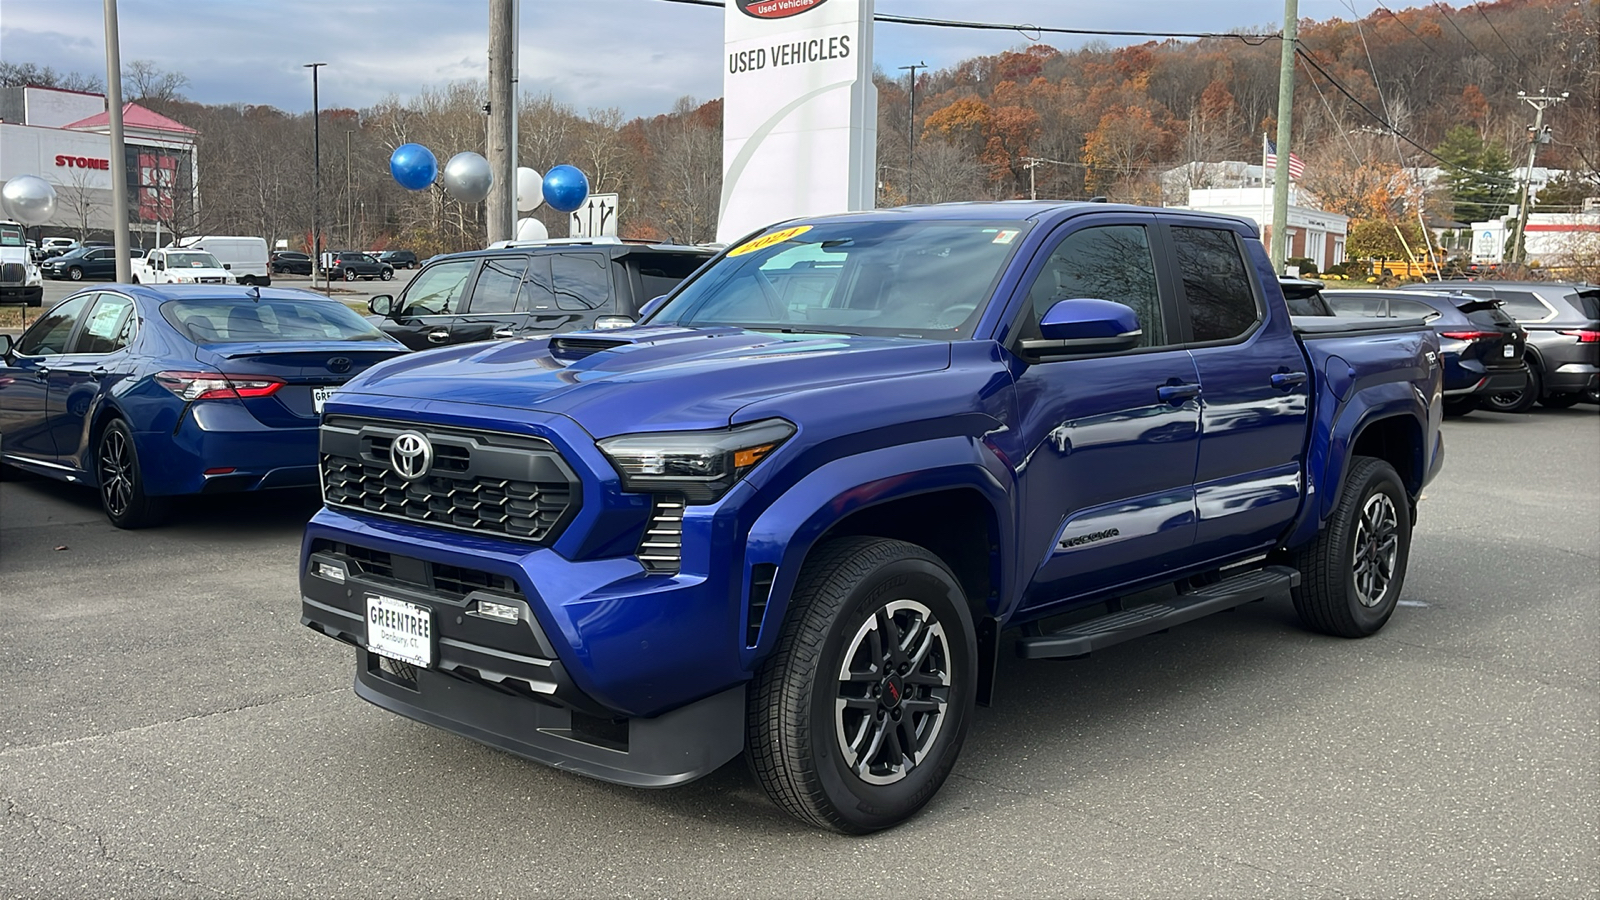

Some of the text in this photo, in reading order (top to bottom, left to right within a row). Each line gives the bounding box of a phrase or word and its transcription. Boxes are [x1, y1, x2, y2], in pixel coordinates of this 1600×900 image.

[758, 0, 814, 14] Used Vehicles
[729, 35, 850, 74] USED VEHICLES
[55, 155, 110, 171] STONE
[739, 228, 800, 254] 2024
[370, 606, 429, 638] GREENTREE
[381, 629, 409, 648] Danbury,
